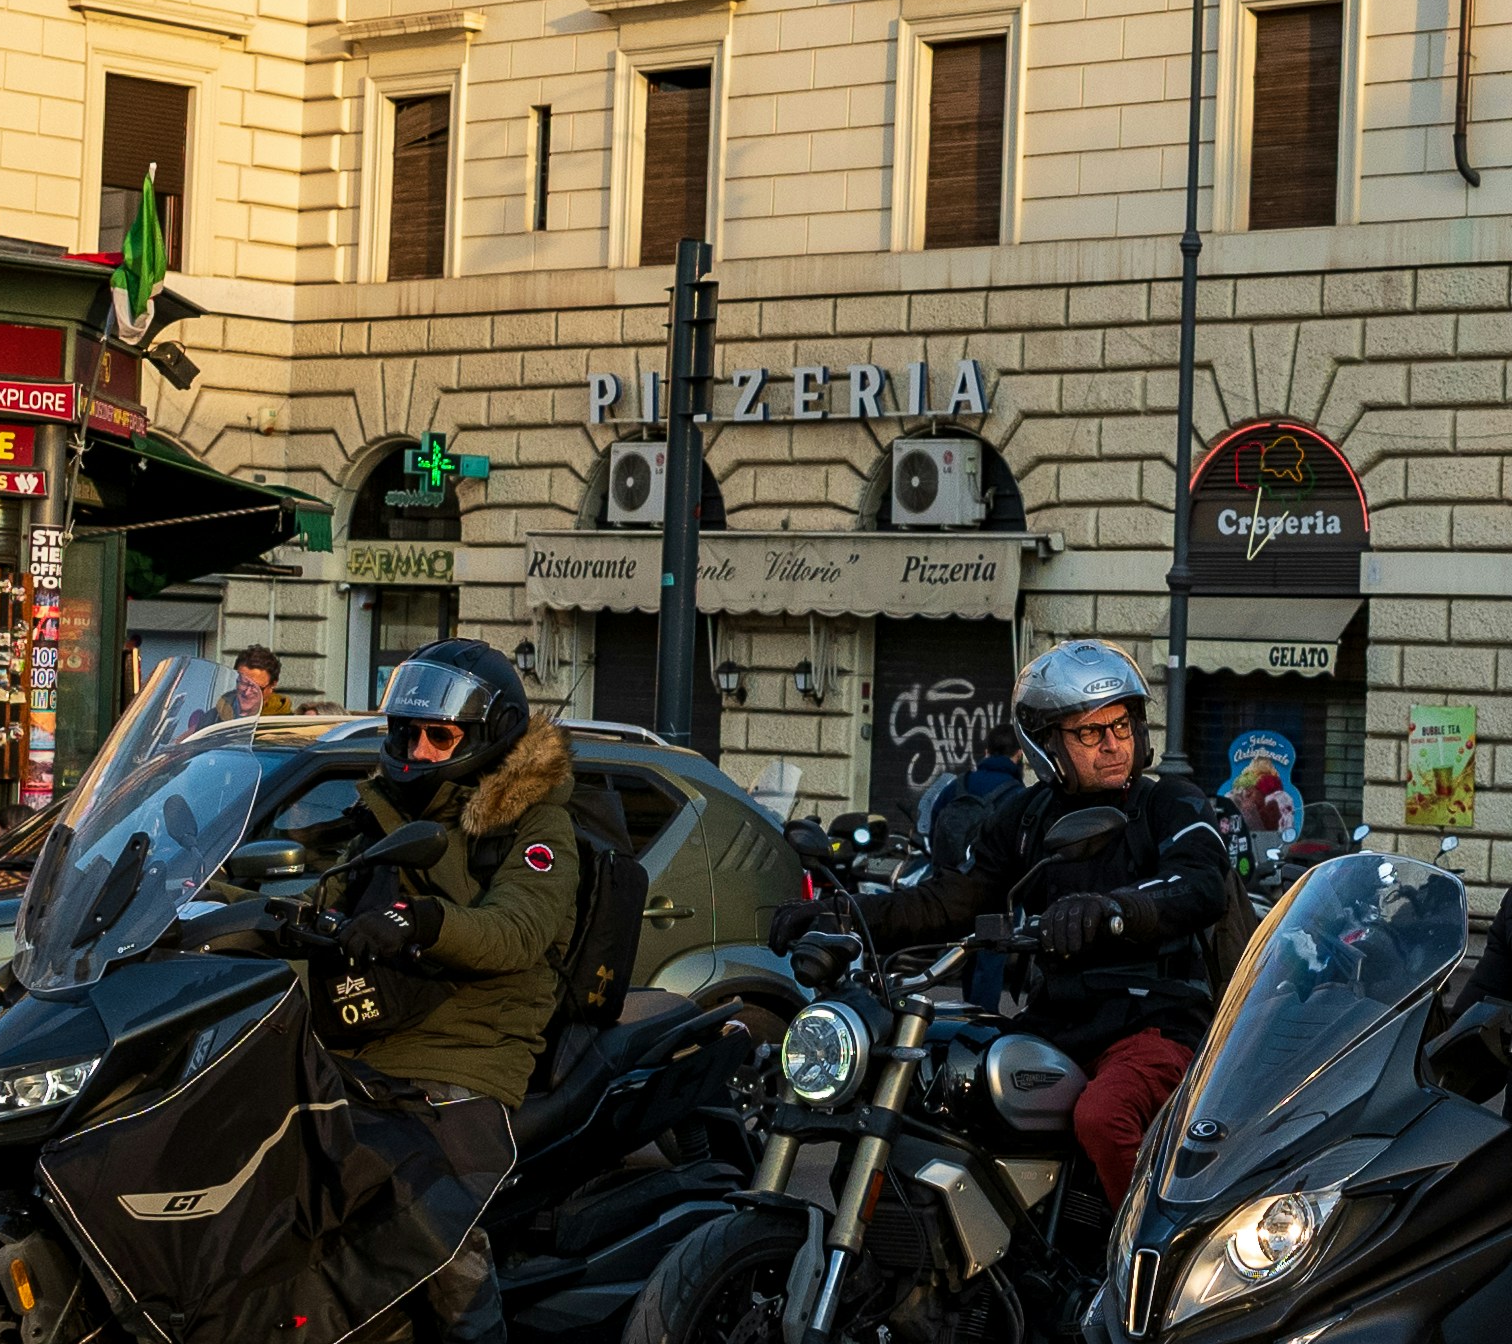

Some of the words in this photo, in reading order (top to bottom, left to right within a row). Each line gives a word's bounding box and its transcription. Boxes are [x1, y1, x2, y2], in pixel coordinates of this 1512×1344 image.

[589, 359, 990, 424] PIZERIA
[1217, 508, 1342, 540] Creperia
[528, 549, 637, 581] Ristorante
[900, 554, 998, 586] Pizzeria
[1269, 646, 1329, 668] GELATO
[1090, 680, 1120, 691] HJC
[395, 697, 431, 708] SHARK
[1421, 725, 1445, 736] BUBBLE
[1448, 724, 1461, 735] TEA
[163, 1193, 208, 1212] GT
